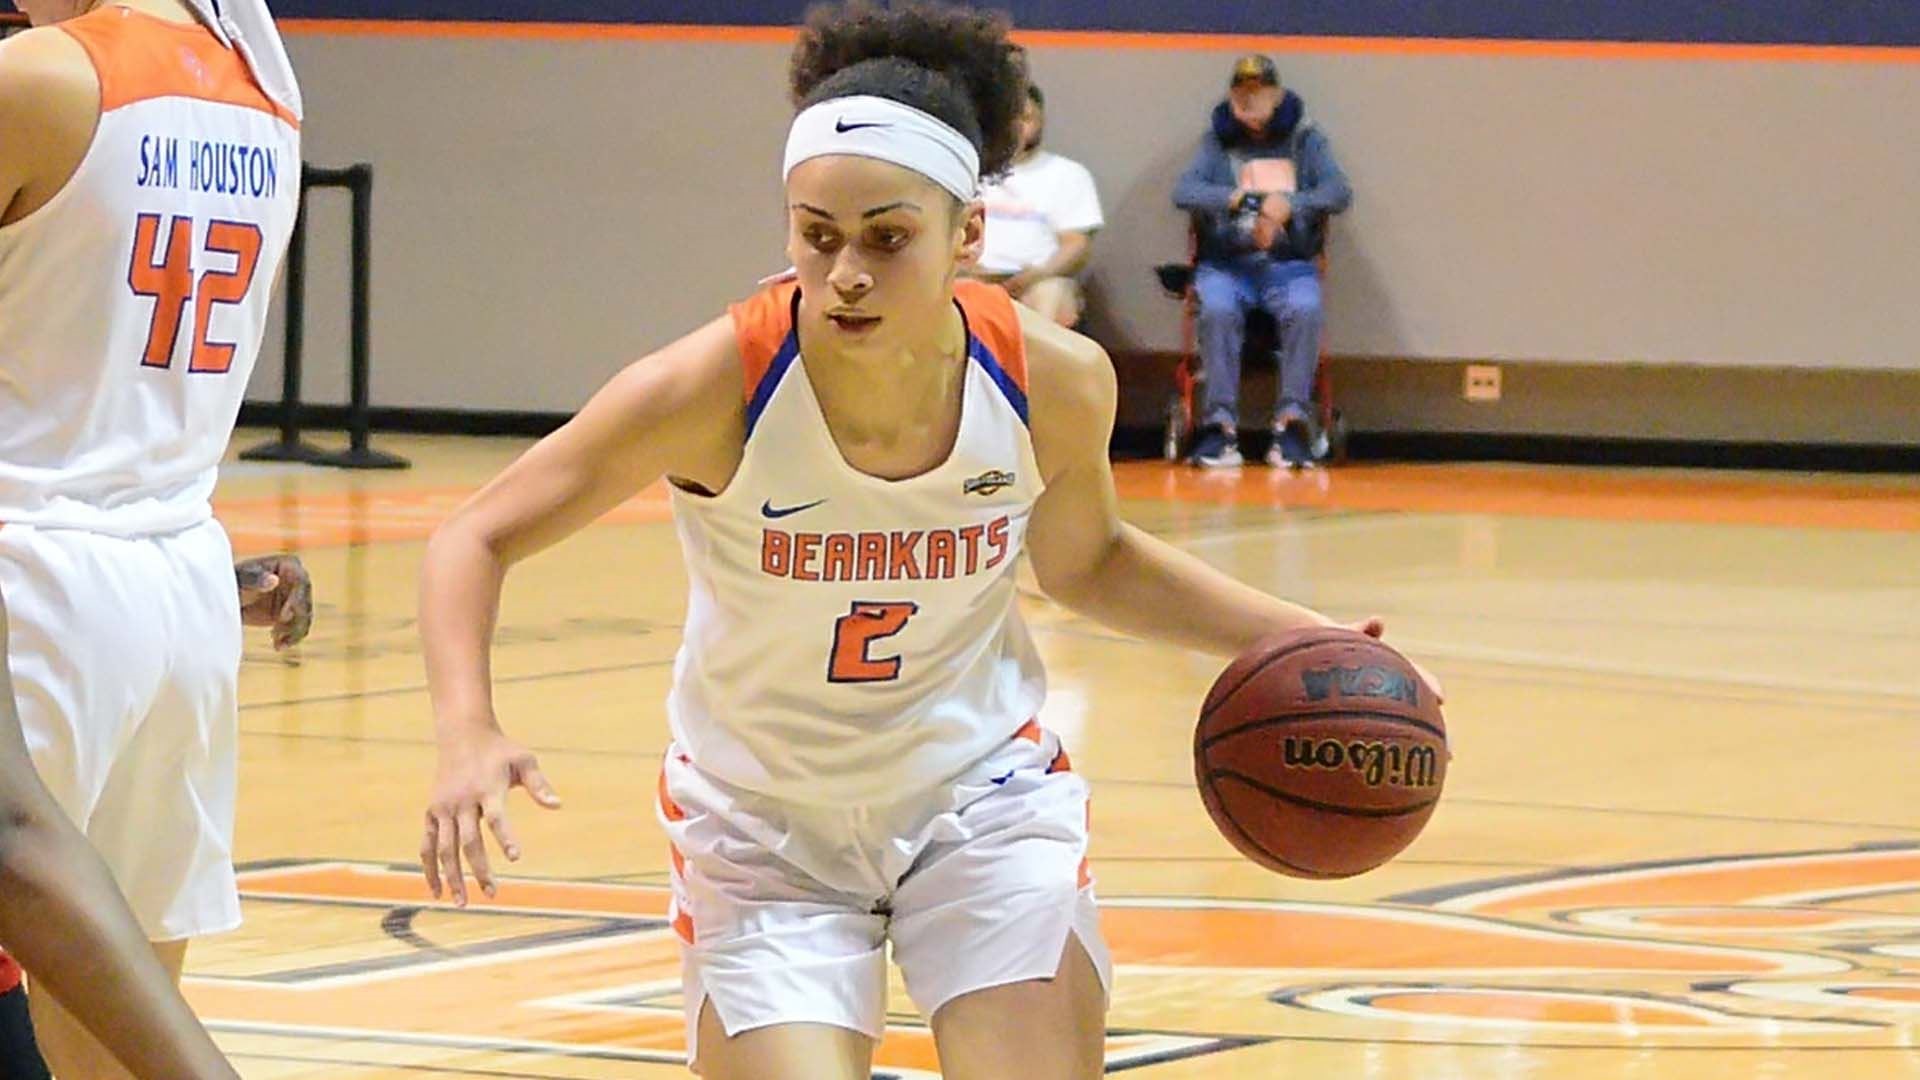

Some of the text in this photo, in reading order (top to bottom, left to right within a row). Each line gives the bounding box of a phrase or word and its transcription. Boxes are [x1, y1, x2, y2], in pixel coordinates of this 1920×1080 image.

[137, 134, 279, 198] SAM HOUSTON
[128, 212, 263, 373] 42
[761, 515, 1010, 581] BEARKATS
[827, 600, 919, 683] 2
[1283, 737, 1436, 786] Wilson
